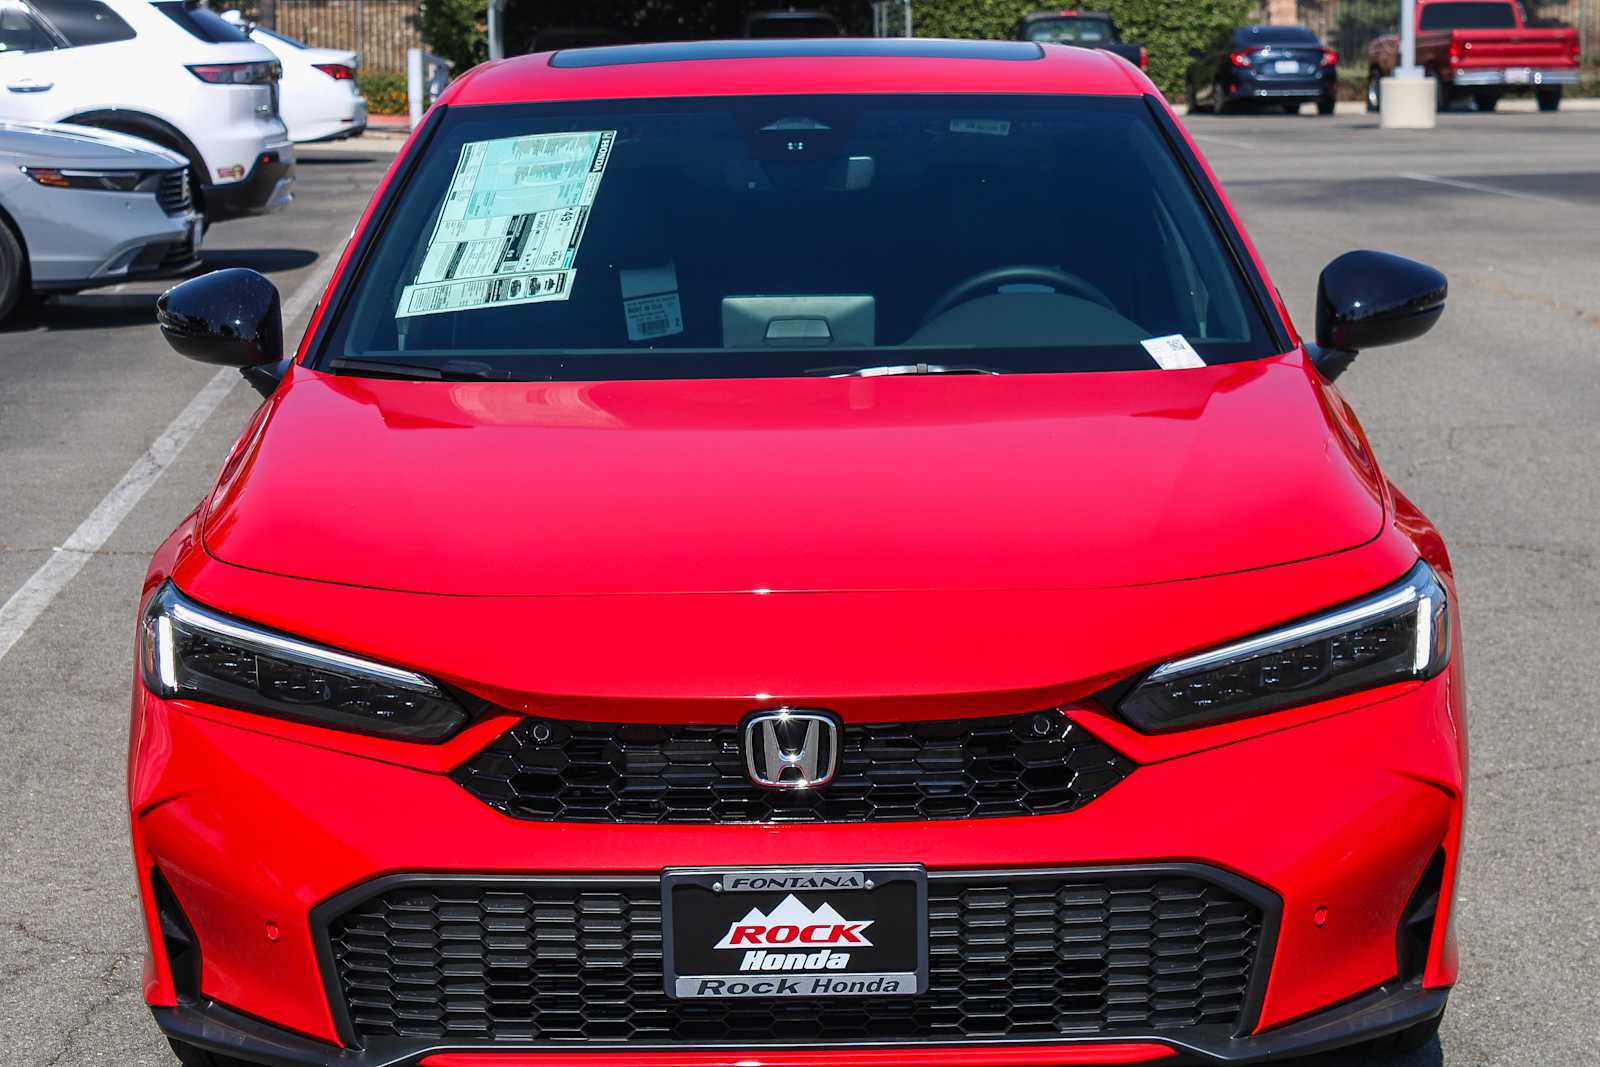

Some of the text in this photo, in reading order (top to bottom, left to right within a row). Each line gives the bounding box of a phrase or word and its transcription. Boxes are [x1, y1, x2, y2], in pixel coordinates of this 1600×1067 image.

[593, 139, 610, 172] HONDA
[731, 876, 860, 890] FONTANA
[729, 924, 862, 945] ROCK
[739, 949, 851, 971] Honda
[697, 978, 900, 995] Rock Honda
